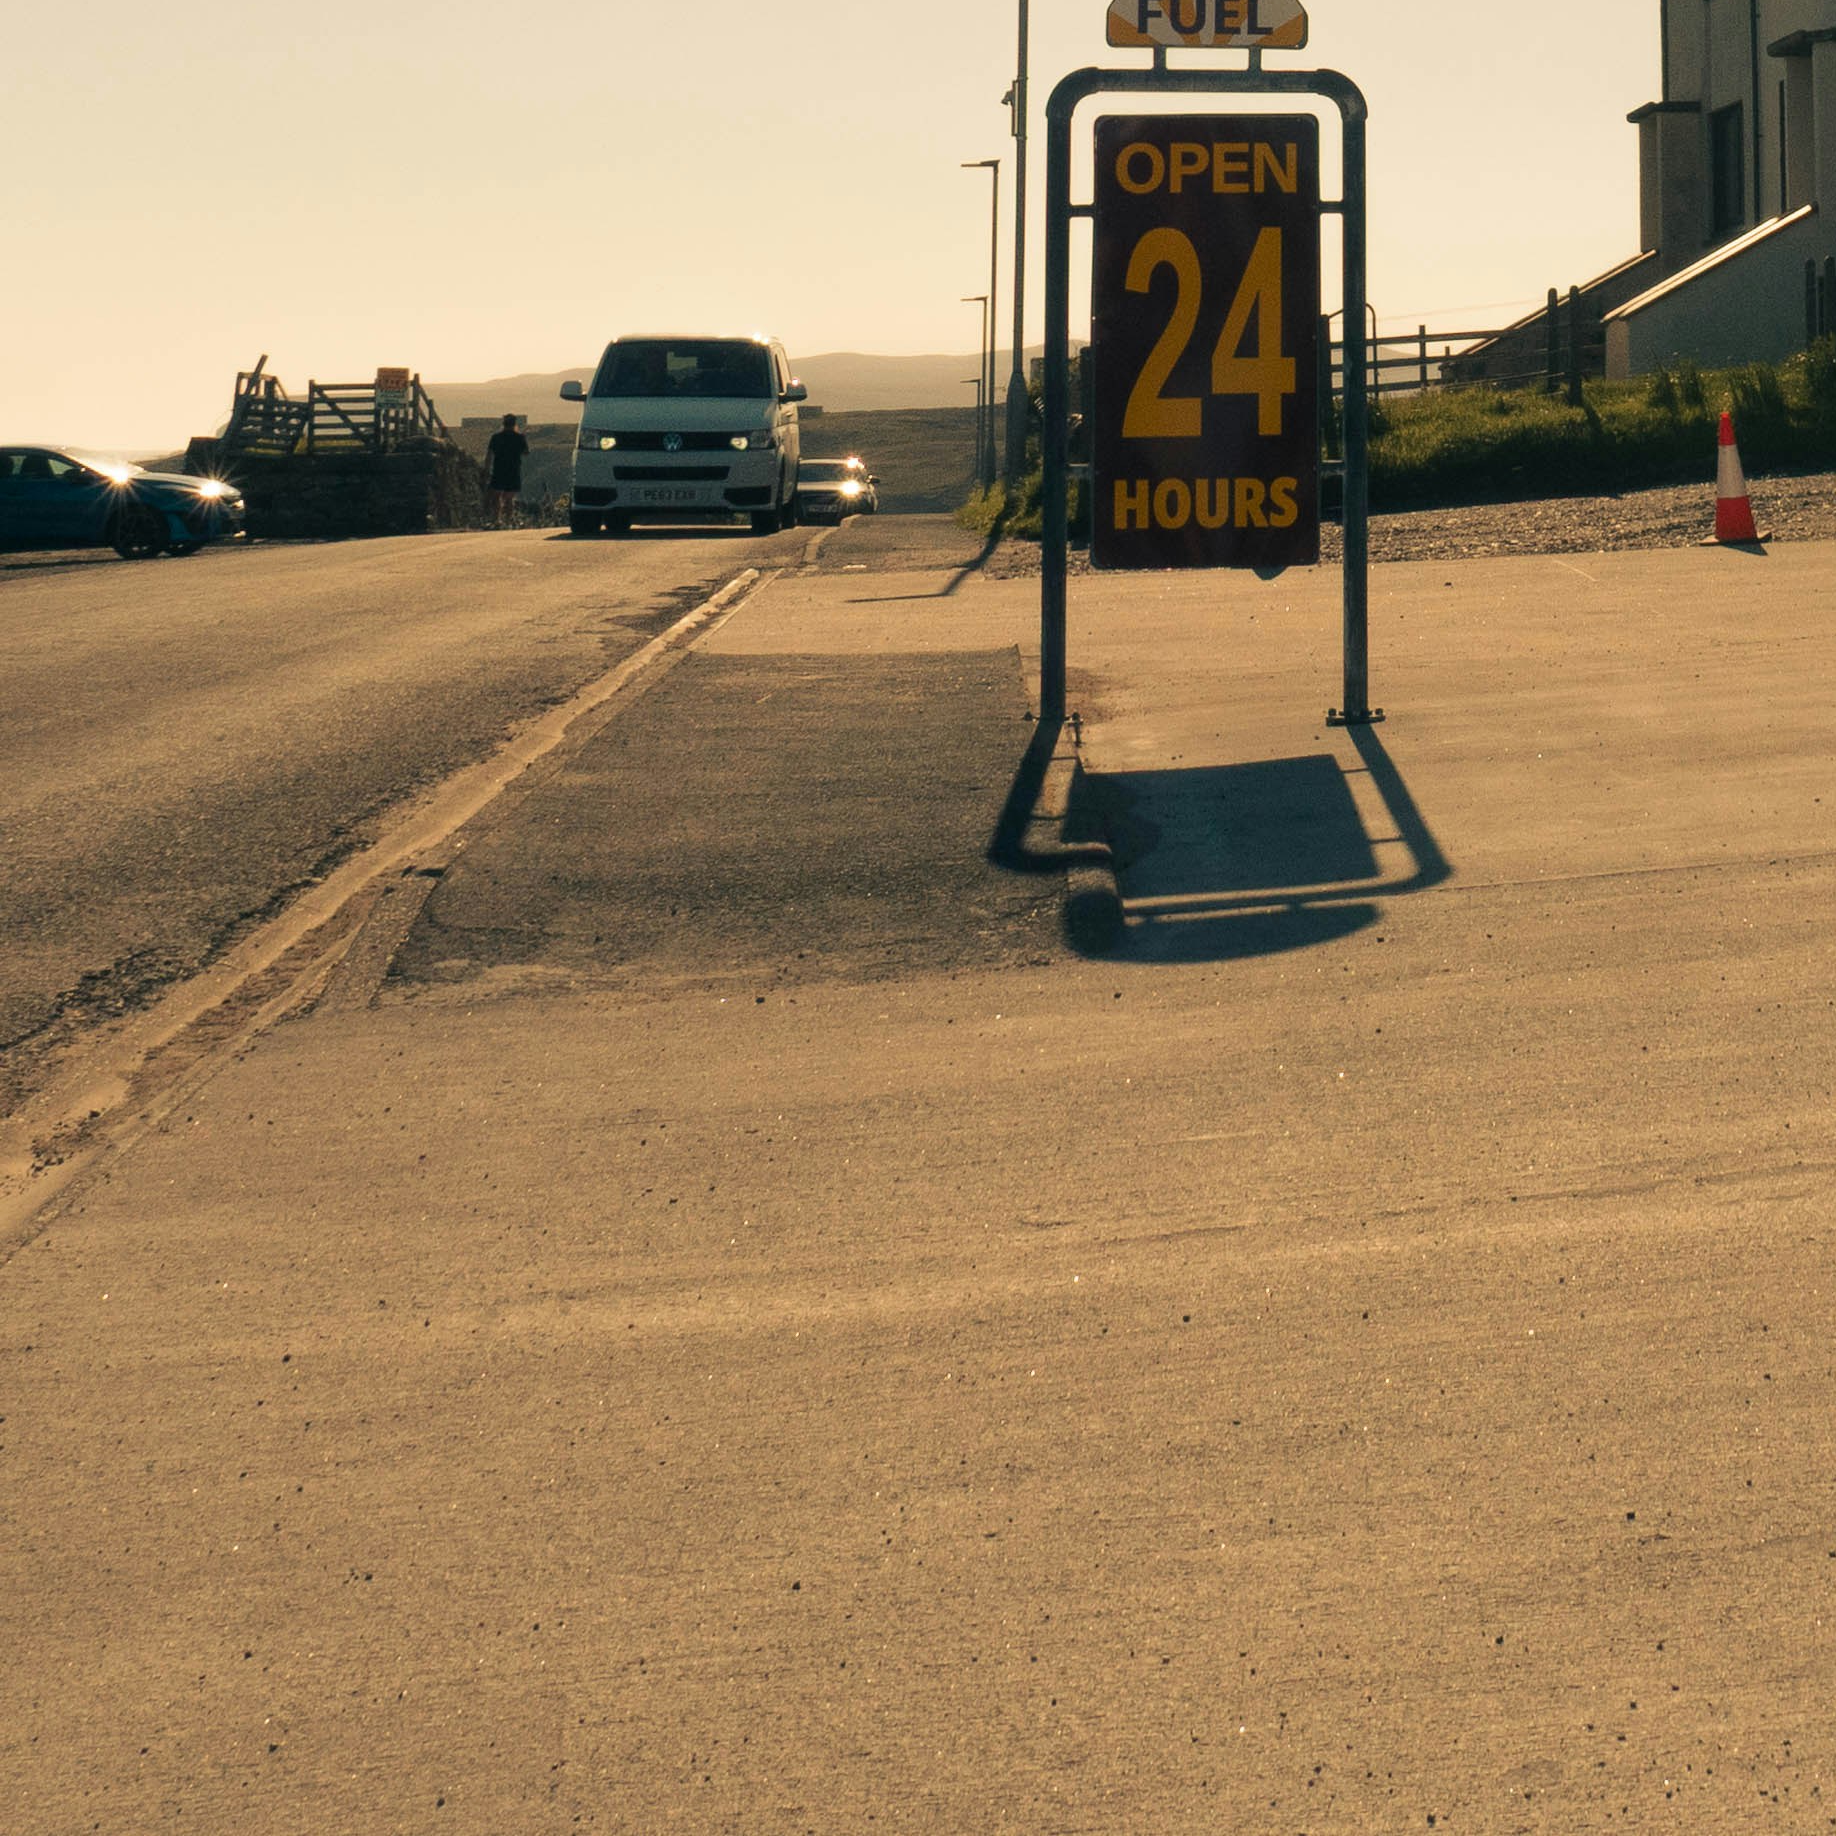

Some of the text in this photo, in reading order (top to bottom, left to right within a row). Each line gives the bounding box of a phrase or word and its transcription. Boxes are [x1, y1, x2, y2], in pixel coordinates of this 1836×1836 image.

[1115, 142, 1298, 194] OPEN
[1121, 226, 1297, 439] 24
[1114, 475, 1299, 530] HOURS
